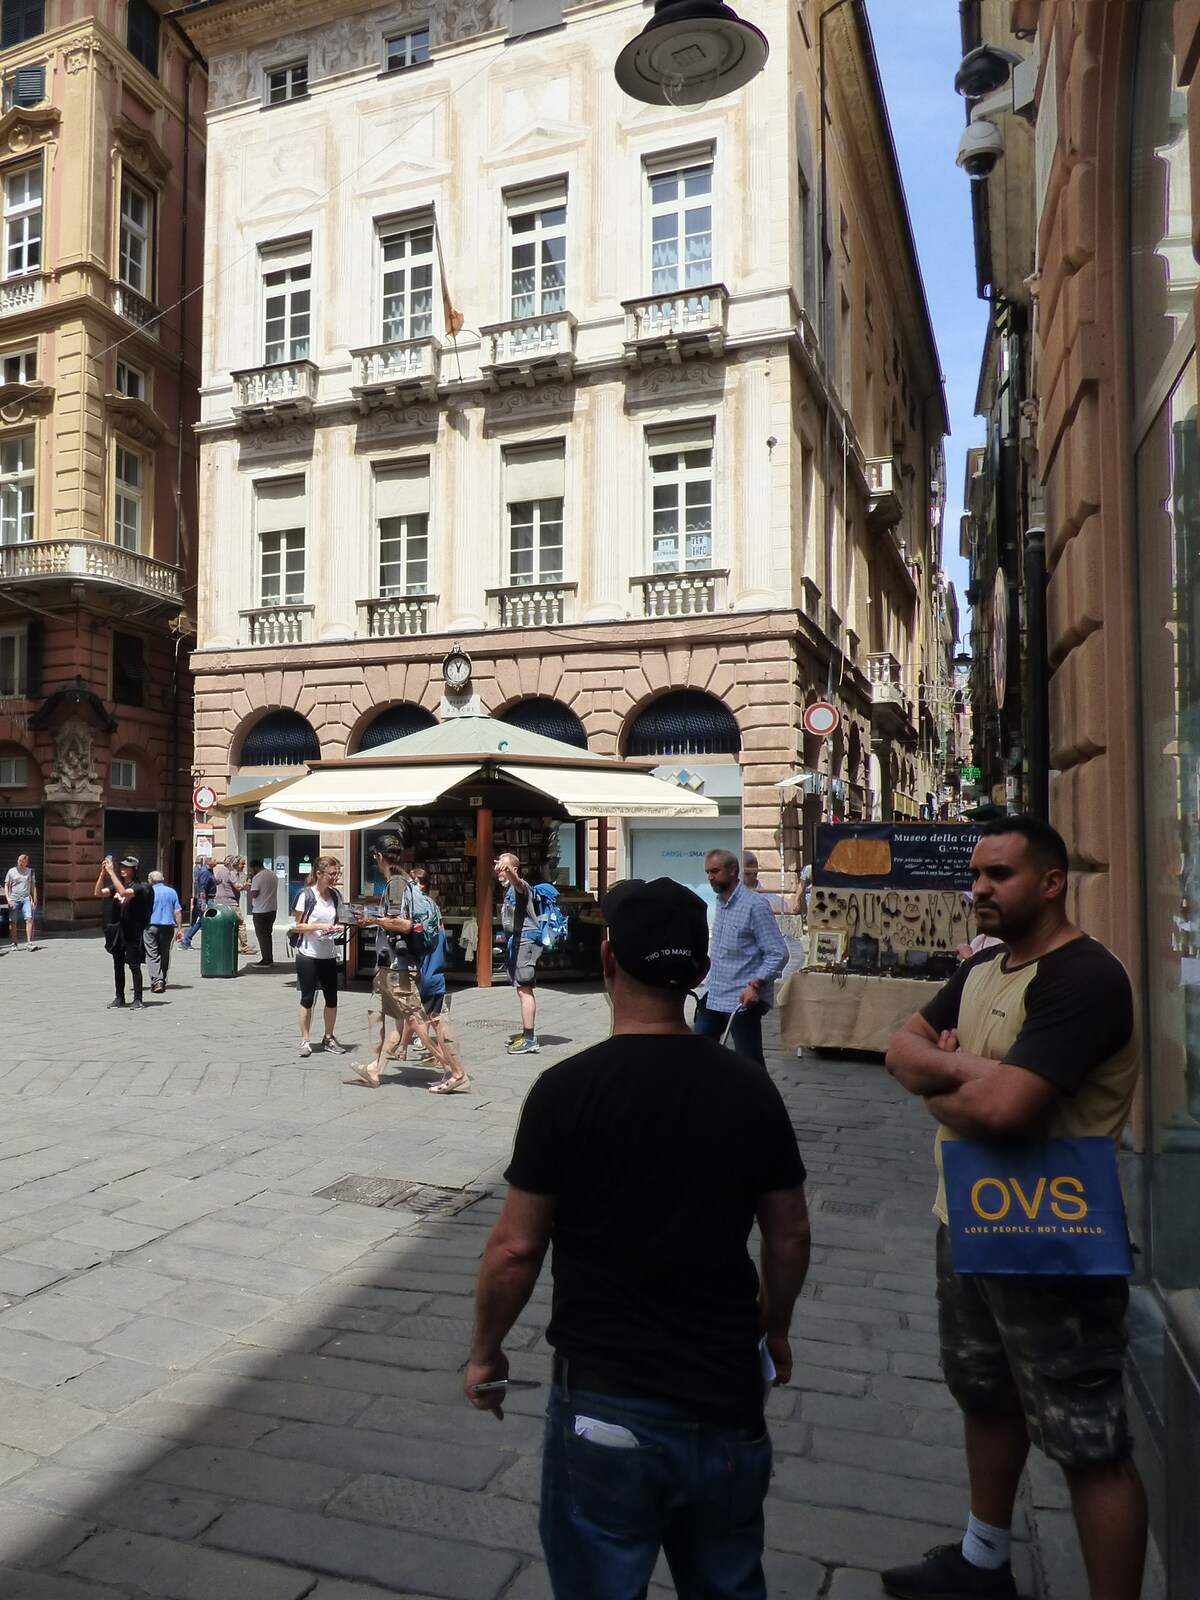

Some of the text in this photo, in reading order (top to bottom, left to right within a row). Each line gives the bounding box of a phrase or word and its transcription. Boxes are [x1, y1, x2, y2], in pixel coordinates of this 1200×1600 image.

[1, 827, 41, 836] BORSA
[894, 833, 982, 843] Museo della Citt
[644, 952, 660, 962] TWO
[671, 948, 692, 957] MAKE
[971, 1176, 1088, 1221] OVS
